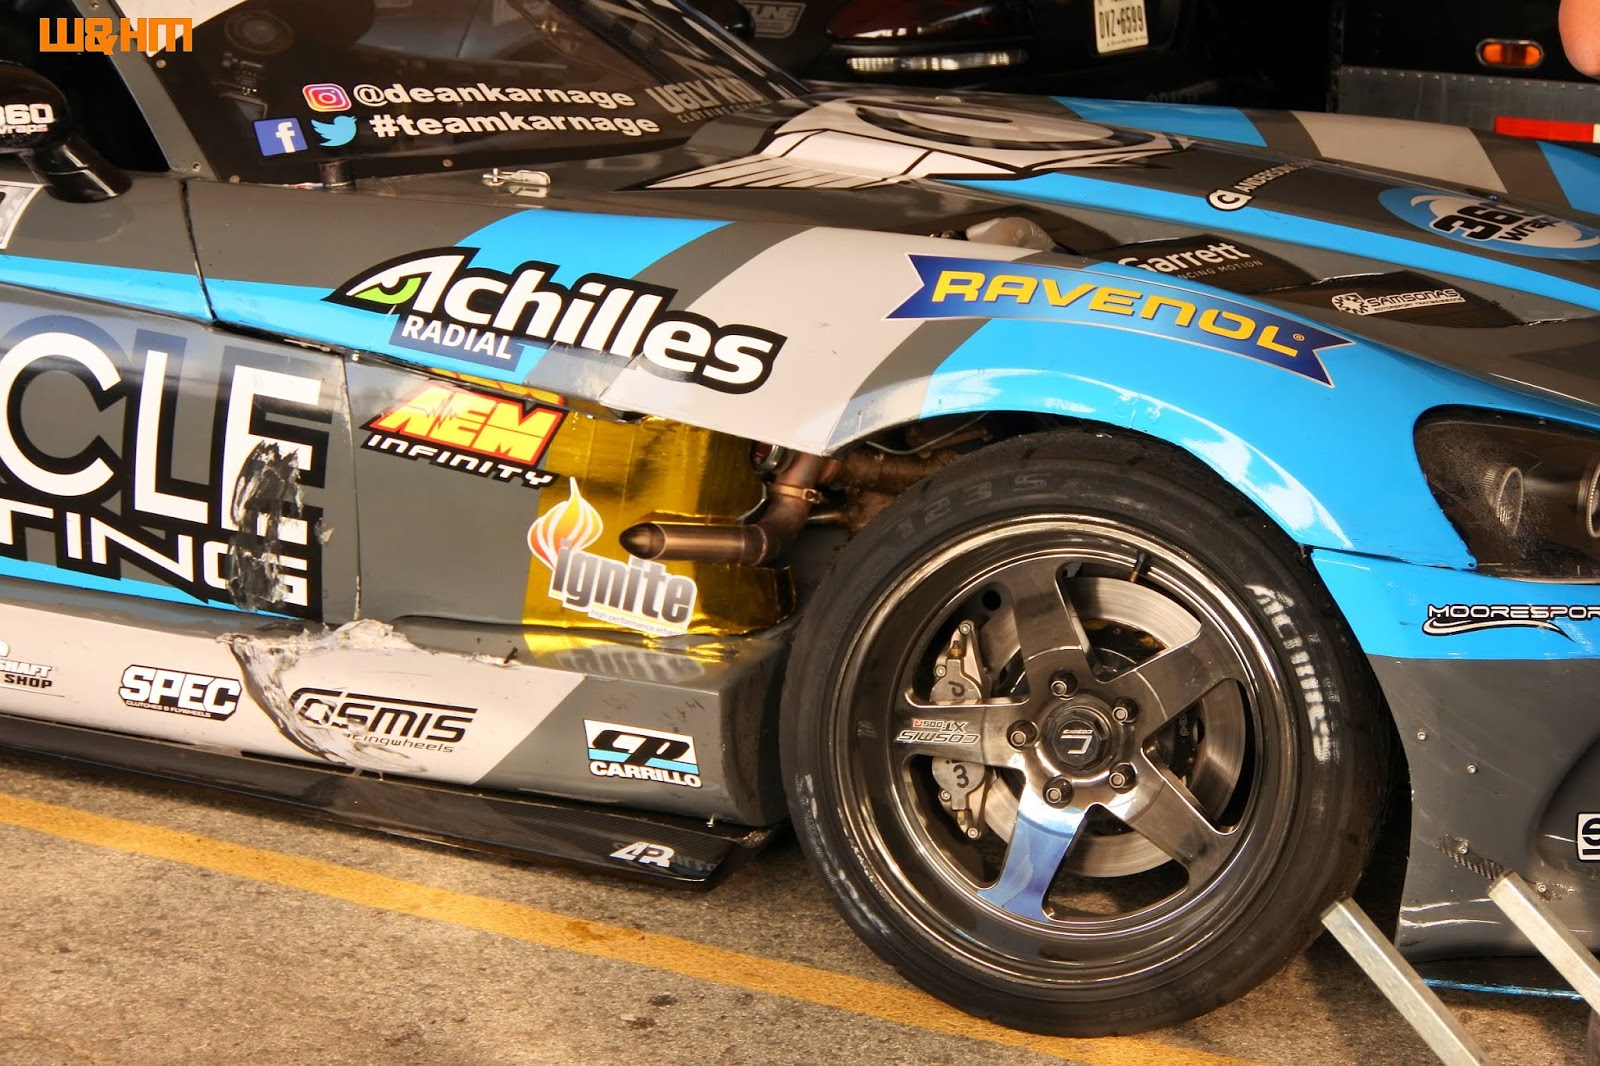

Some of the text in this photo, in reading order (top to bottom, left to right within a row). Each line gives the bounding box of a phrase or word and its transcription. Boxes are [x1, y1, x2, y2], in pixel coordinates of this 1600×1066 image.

[353, 83, 637, 110] @deankarnage
[643, 80, 722, 114] UGLY
[0, 103, 55, 125] 60
[369, 111, 661, 137] #teamkarnage
[1216, 258, 1264, 274] MOTION
[1367, 289, 1460, 307] SAMSONAS
[345, 253, 774, 386] Achilles
[401, 315, 513, 361] RADIAL
[379, 383, 558, 463] AEM
[367, 435, 553, 486] INFINITY
[552, 539, 694, 624] ignite
[4, 673, 53, 689] SHOP
[119, 665, 242, 716] SPEC
[347, 732, 455, 753] cingwheels
[592, 729, 690, 766] CP
[897, 729, 981, 745] COSMIS
[590, 761, 702, 788] CARRILLO
